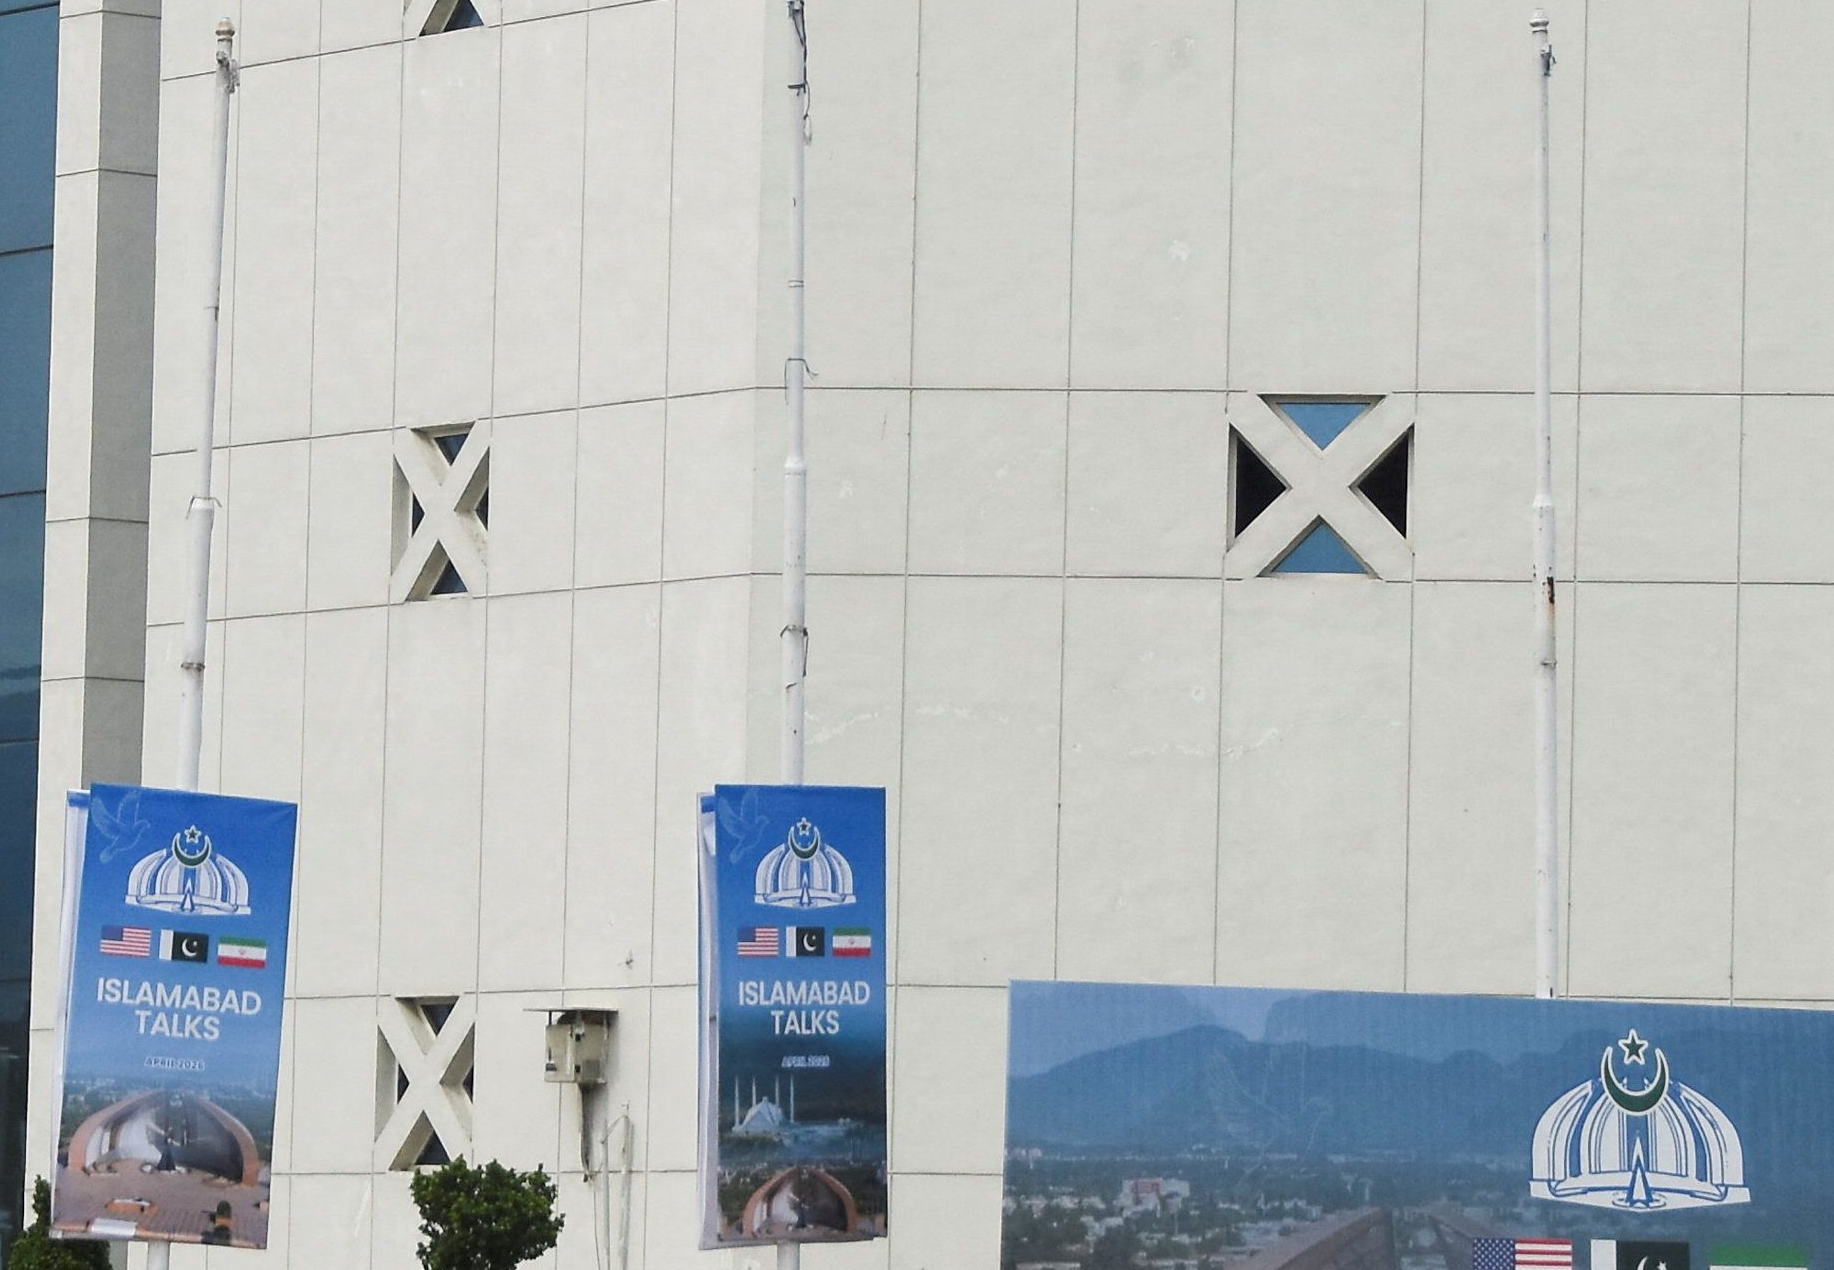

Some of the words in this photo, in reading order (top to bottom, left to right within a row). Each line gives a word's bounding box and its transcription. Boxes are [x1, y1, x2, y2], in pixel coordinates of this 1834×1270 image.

[97, 977, 263, 1016] ISLAMABAD
[738, 980, 871, 1006] ISLAMABAD
[134, 1010, 221, 1041] TALKS
[770, 1010, 840, 1035] TALKS
[144, 1056, 176, 1069] APRIL
